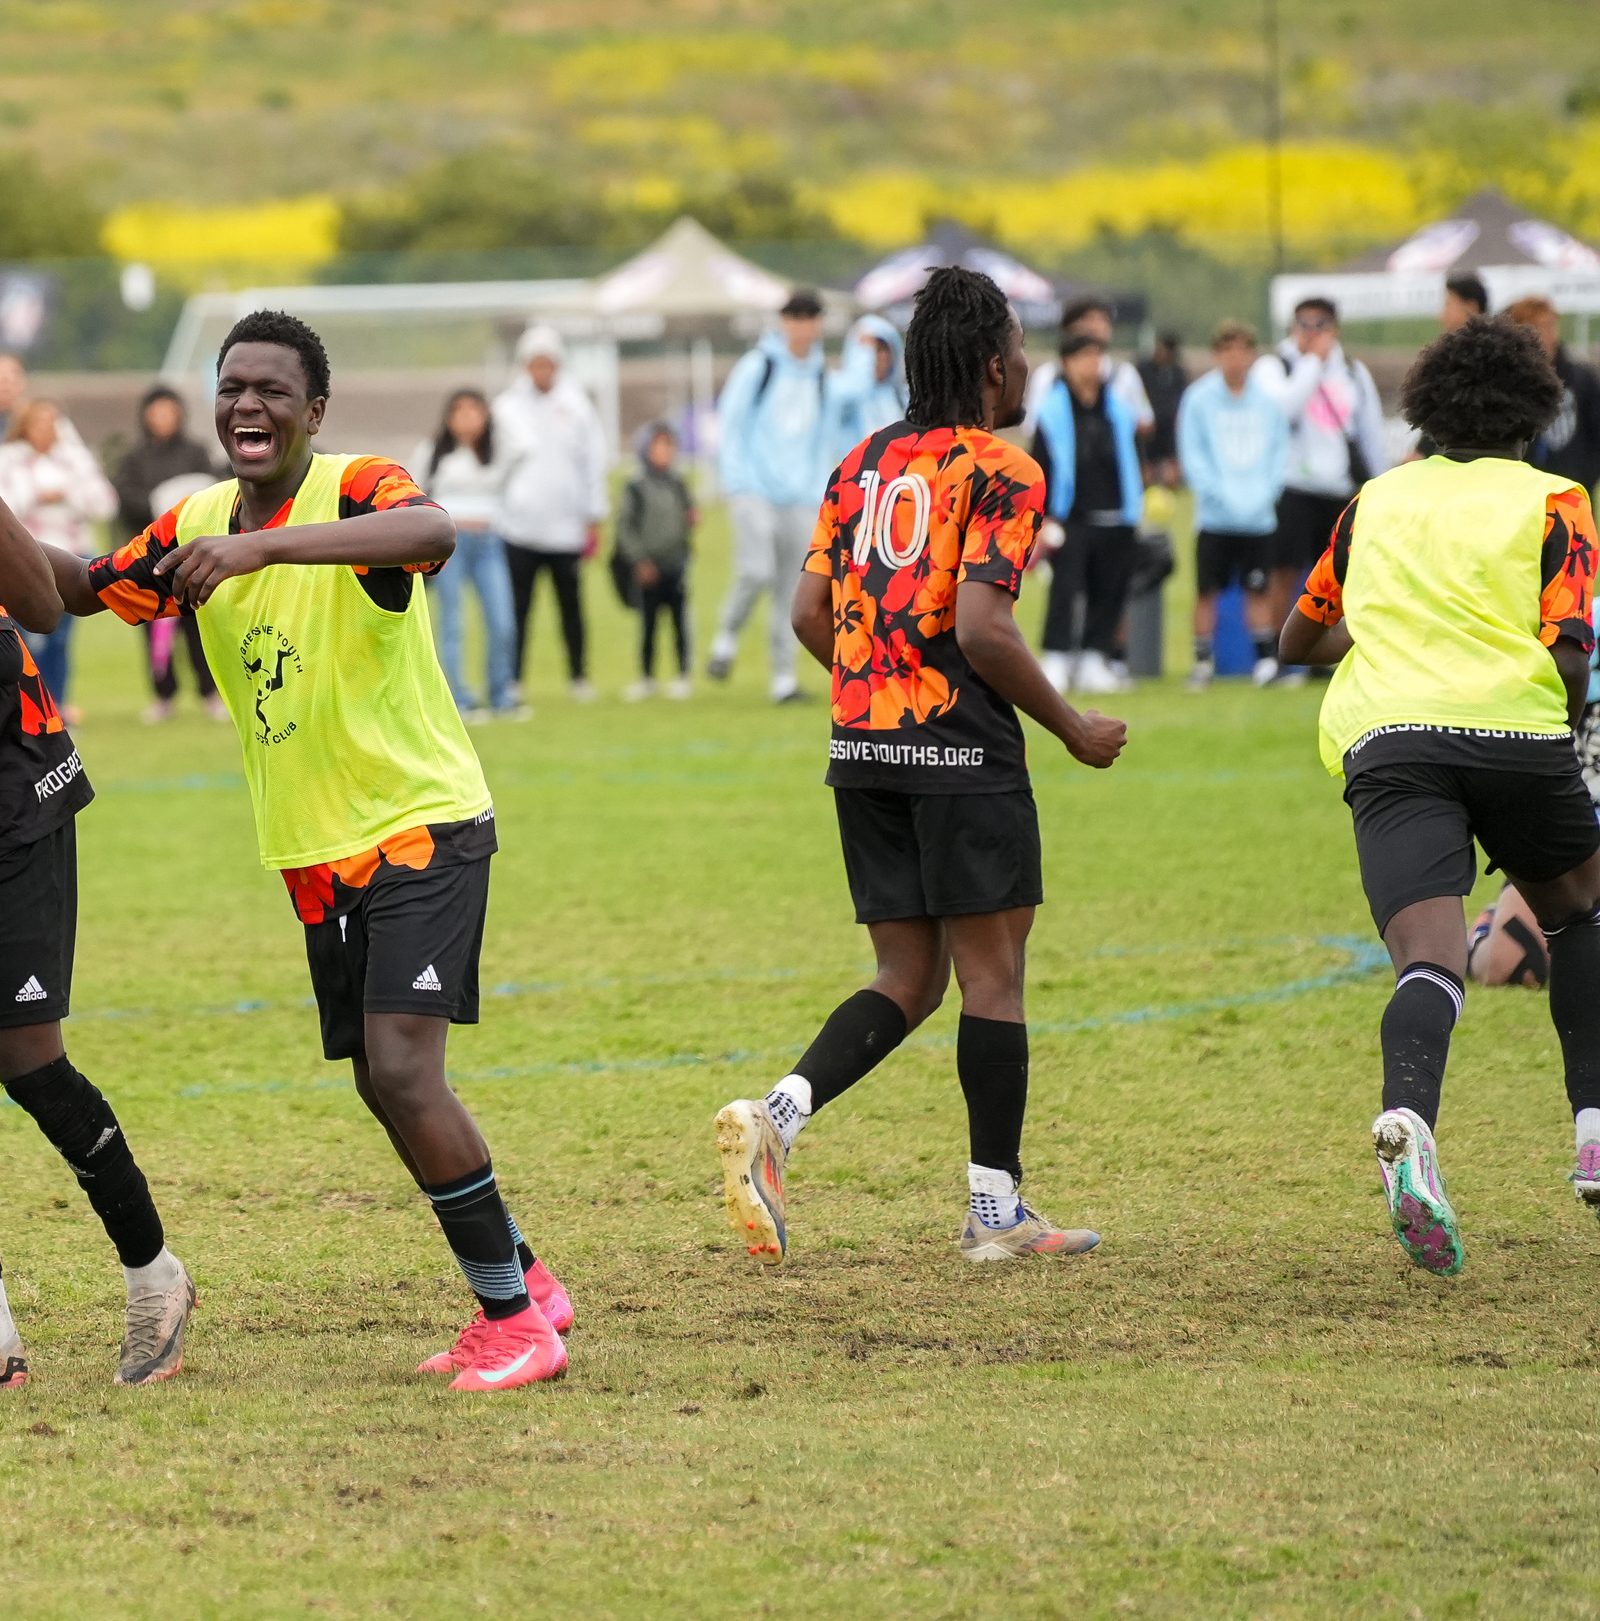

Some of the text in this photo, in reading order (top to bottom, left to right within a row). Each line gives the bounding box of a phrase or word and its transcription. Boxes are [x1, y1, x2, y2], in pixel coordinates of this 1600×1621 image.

[852, 470, 931, 570] 10
[276, 630, 303, 673] YOUTH
[272, 721, 297, 744] CLUB
[15, 991, 47, 1002] adidas
[412, 980, 441, 991] adidas
